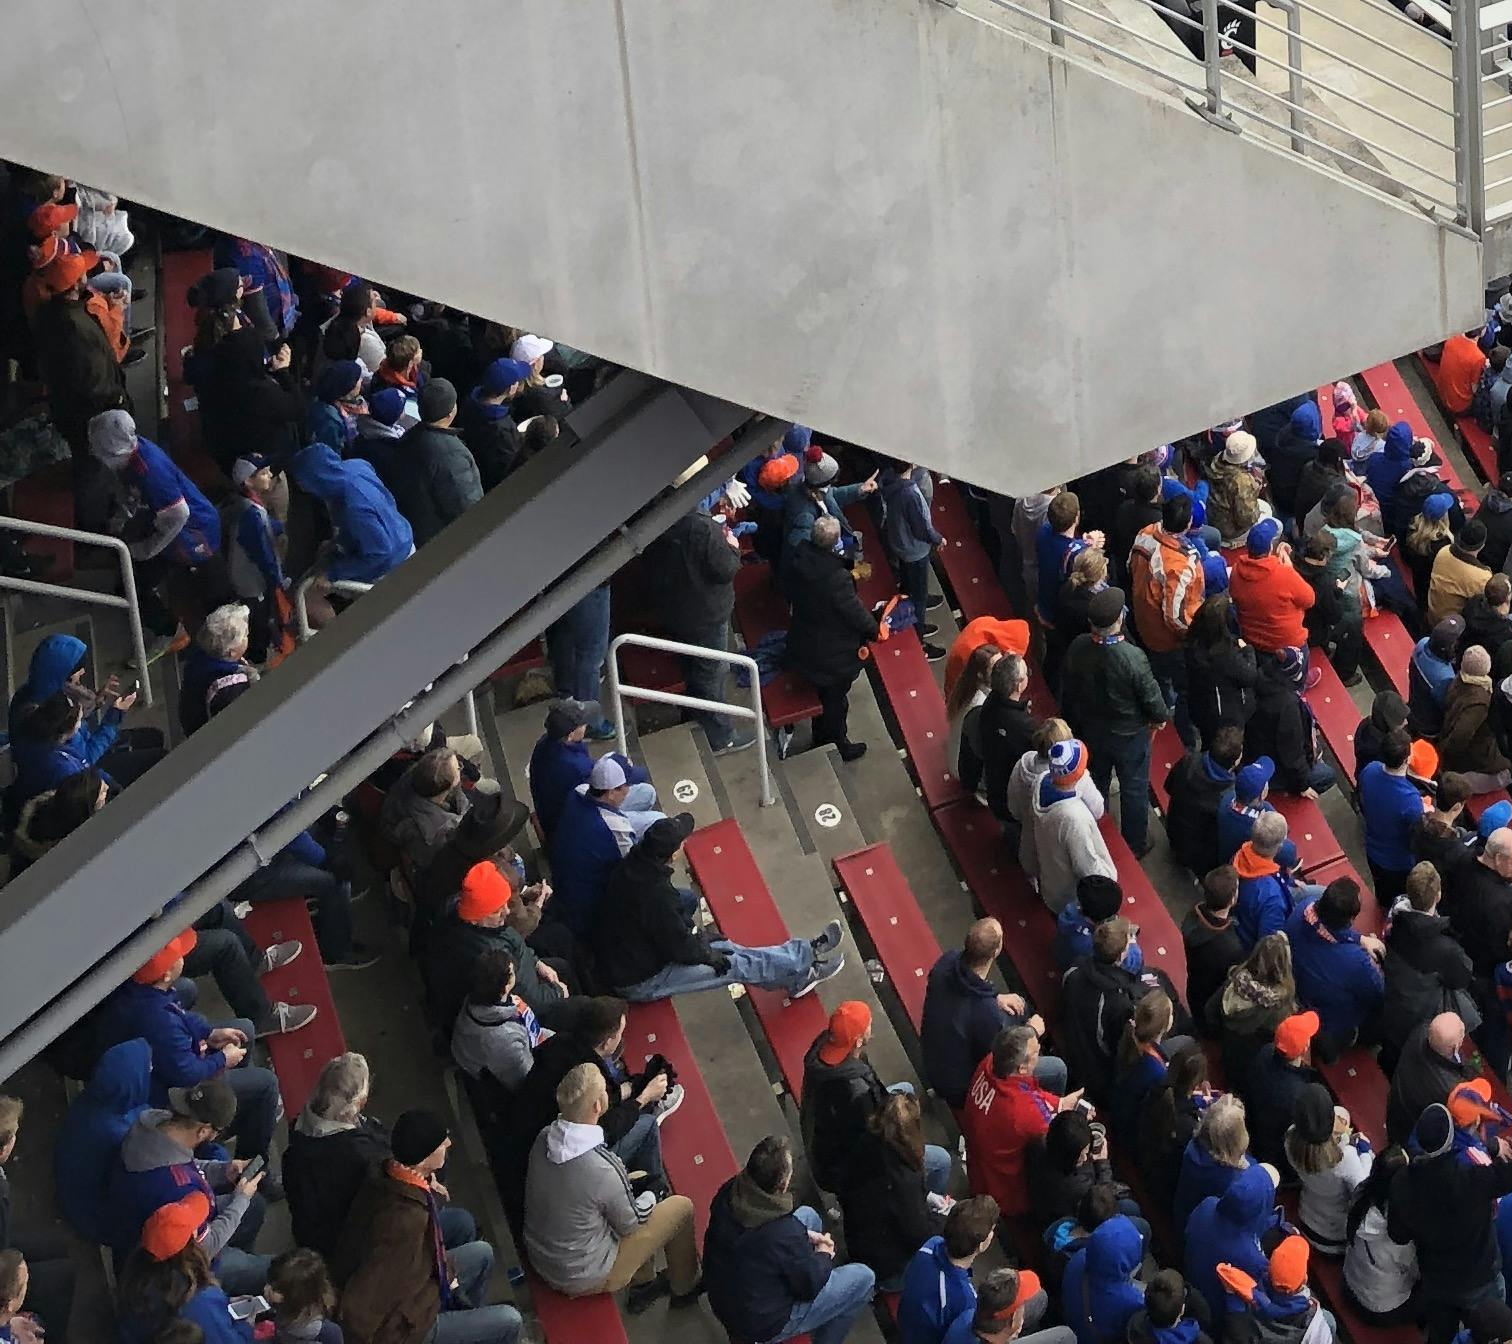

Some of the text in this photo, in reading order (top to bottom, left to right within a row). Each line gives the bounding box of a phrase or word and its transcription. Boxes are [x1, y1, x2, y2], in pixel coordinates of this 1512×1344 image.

[676, 784, 694, 799] 29
[818, 807, 837, 823] 28
[971, 1070, 996, 1116] USA
